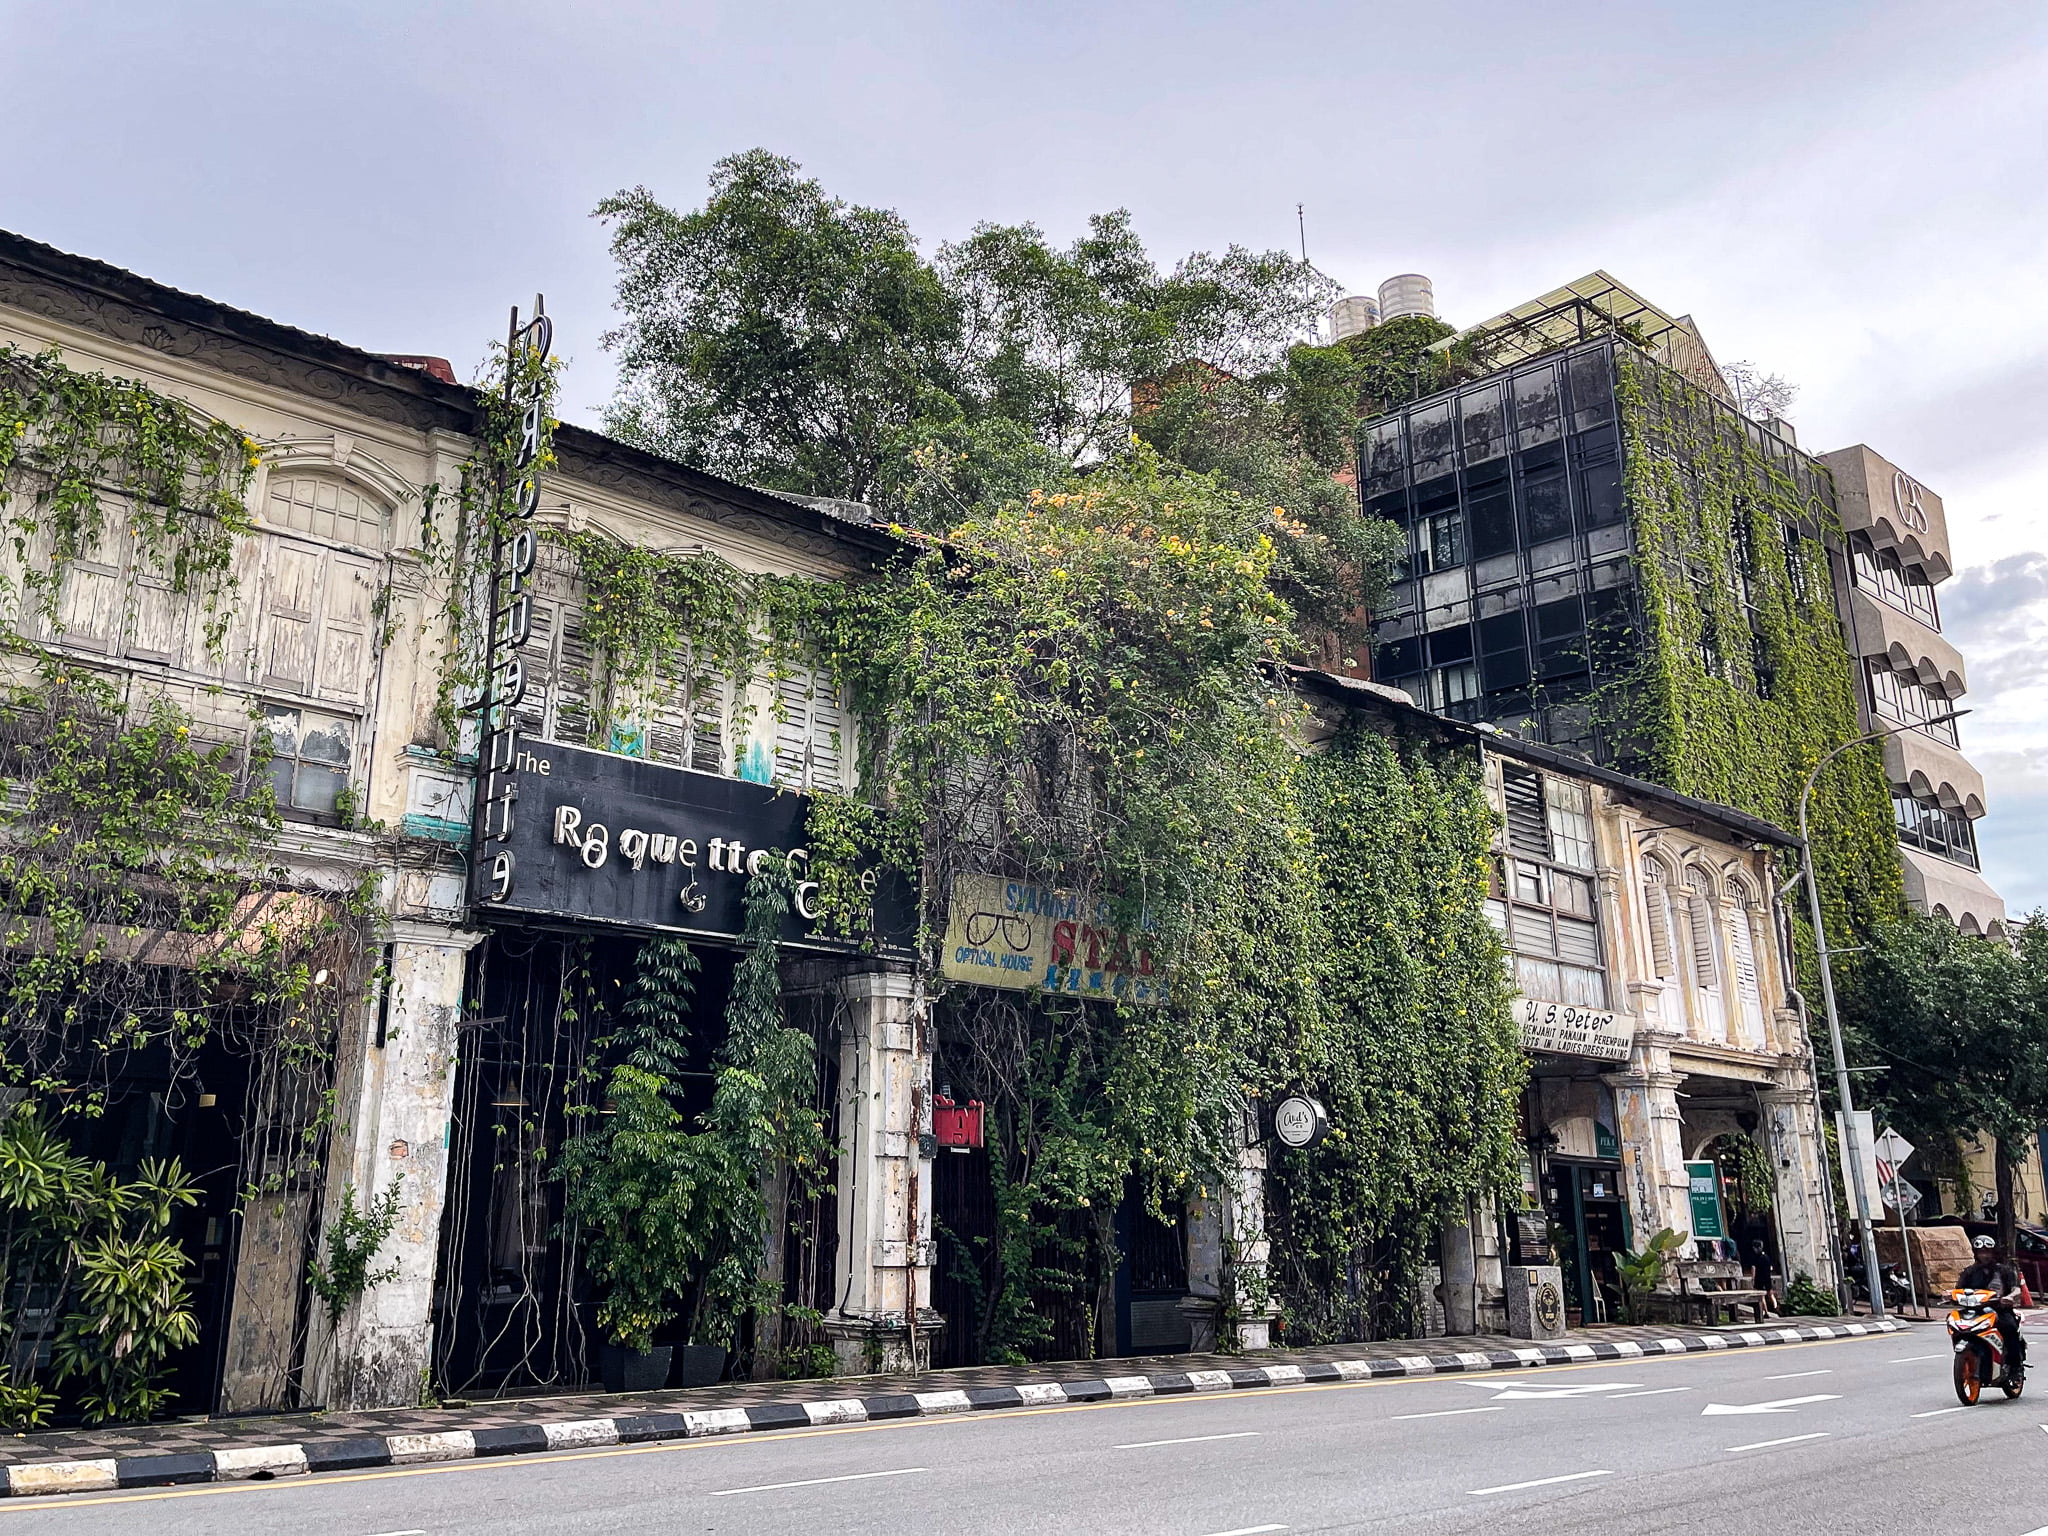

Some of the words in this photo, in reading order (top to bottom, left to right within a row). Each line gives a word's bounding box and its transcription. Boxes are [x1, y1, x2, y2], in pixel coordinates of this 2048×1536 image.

[515, 750, 551, 776] The
[955, 946, 998, 968] OPTICAL
[1000, 954, 1034, 972] HOUSE
[1526, 1000, 1538, 1024] U.
[1545, 1004, 1557, 1024] S.
[1563, 1007, 1614, 1032] Peter
[1543, 1039, 1553, 1049] IN
[1557, 1040, 1582, 1053] LADIES
[1582, 1044, 1605, 1057] DRESS
[1593, 1034, 1630, 1049] PEREMPUAN
